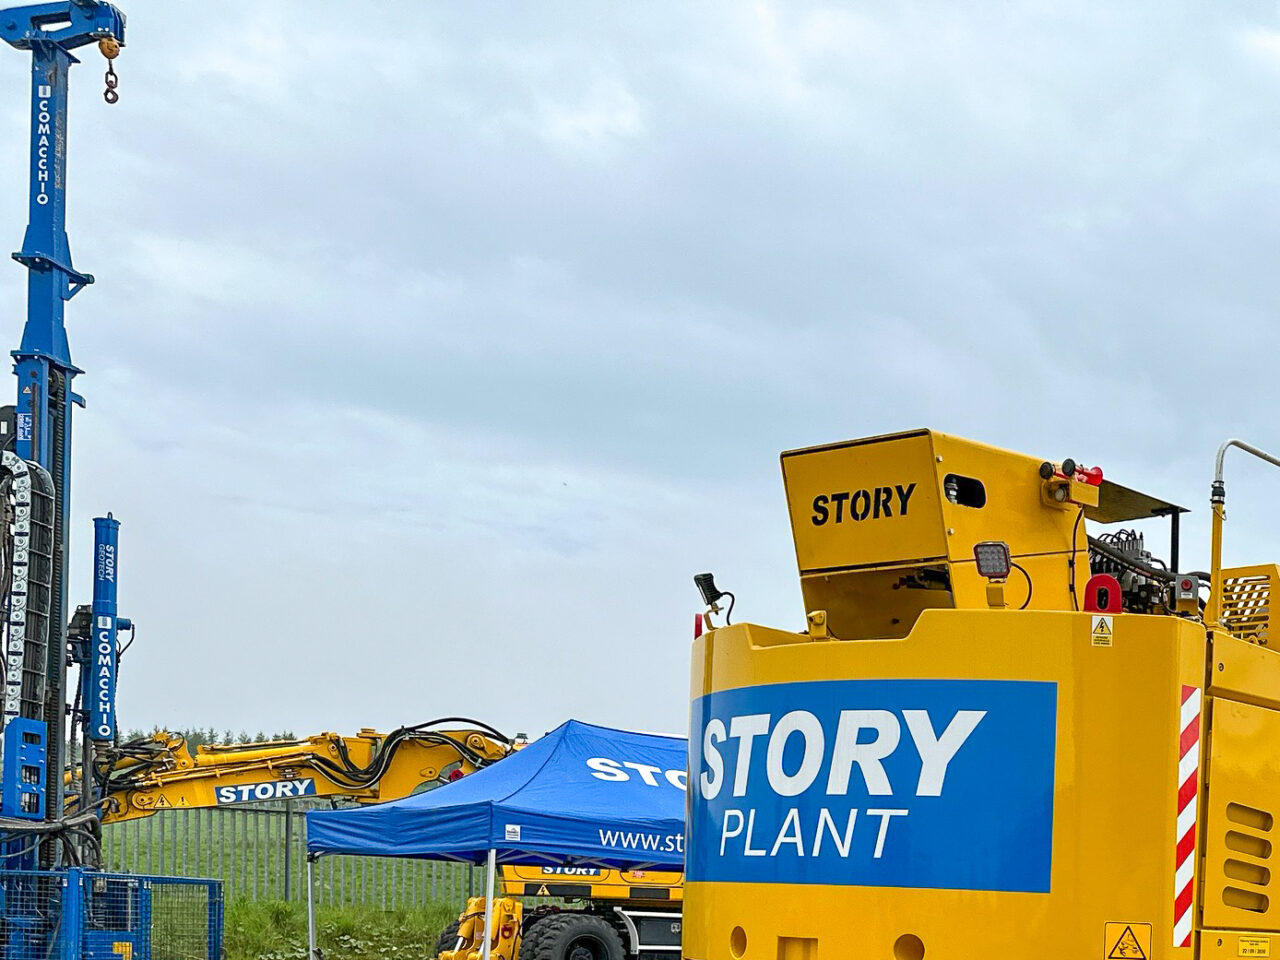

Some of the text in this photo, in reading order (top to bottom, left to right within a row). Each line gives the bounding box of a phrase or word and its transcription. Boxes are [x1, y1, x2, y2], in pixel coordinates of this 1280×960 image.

[36, 100, 51, 205] COMACCHIO
[811, 483, 917, 527] STORY
[97, 543, 105, 581] GEOTECH
[105, 543, 115, 583] STORY
[97, 631, 112, 737] COMACCHIO
[700, 709, 988, 800] STORY
[219, 779, 312, 803] STORY
[719, 808, 909, 858] PLANT
